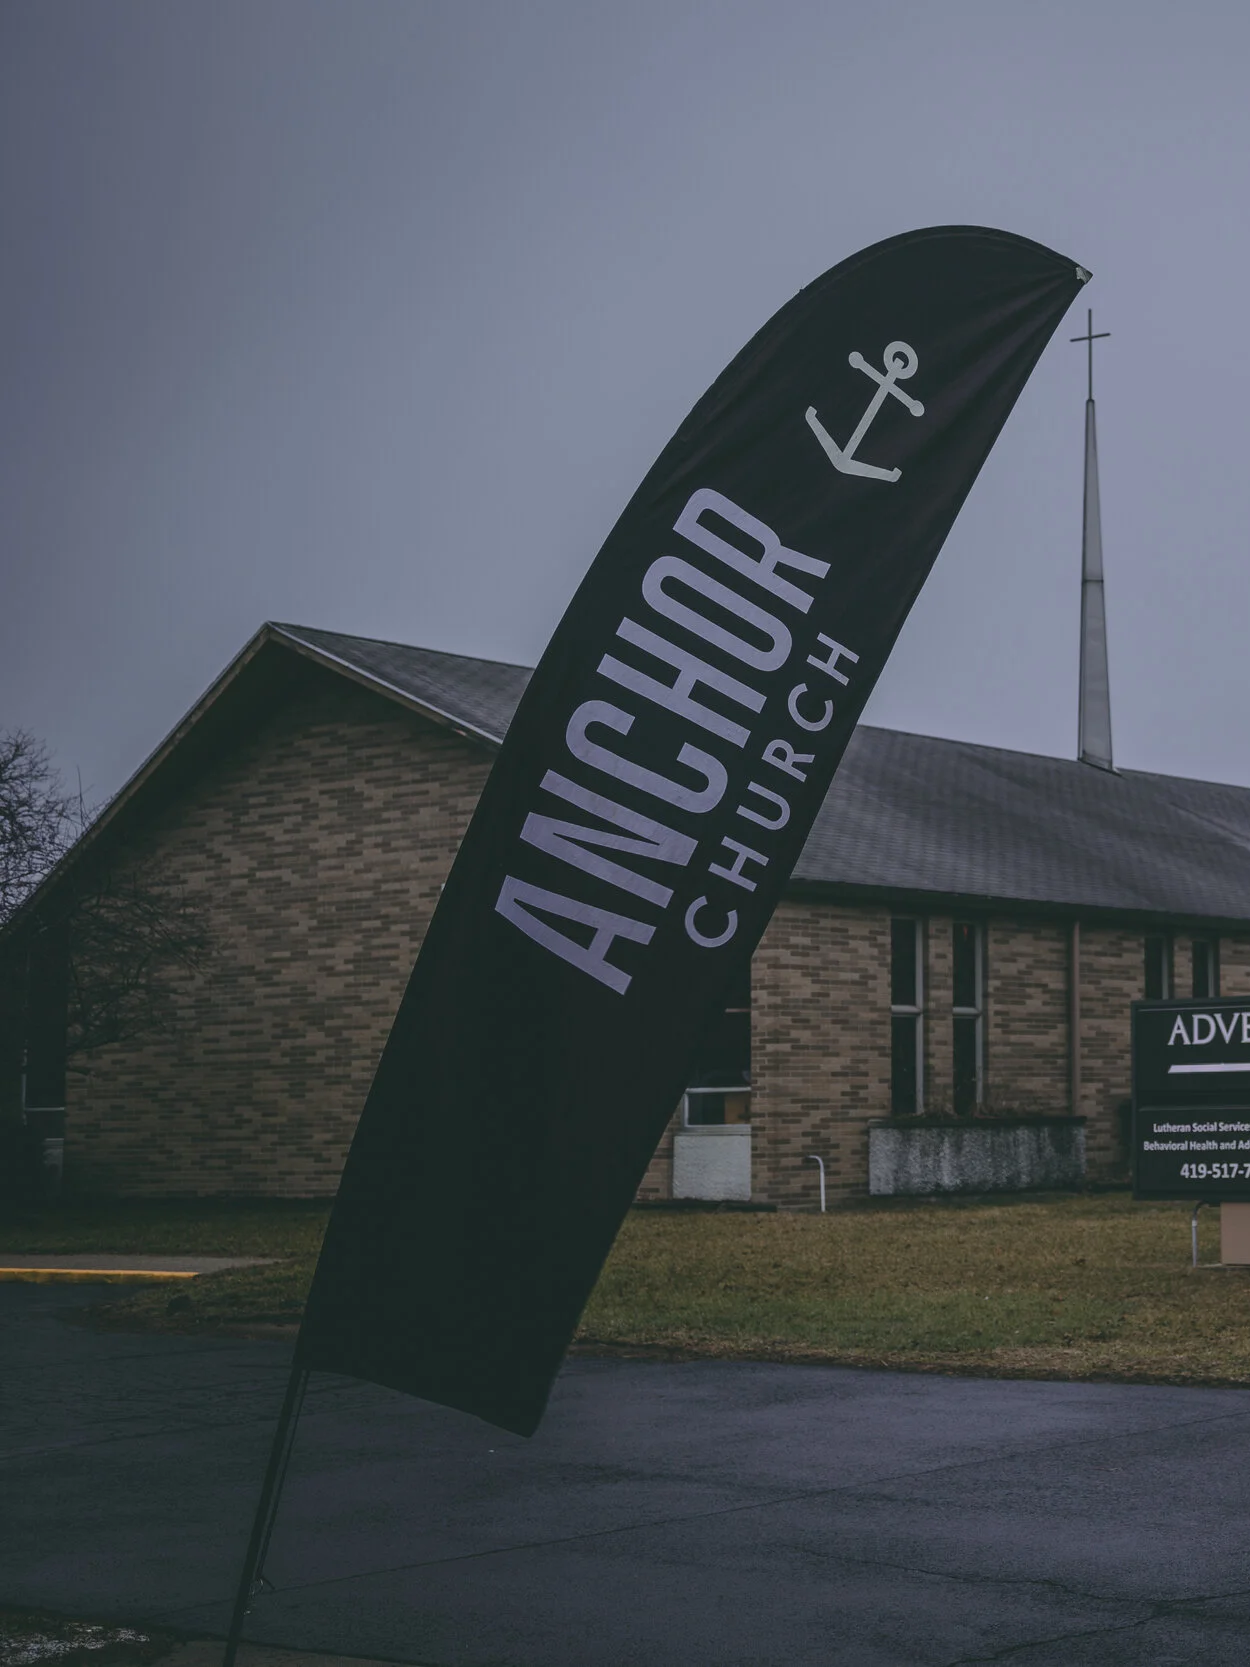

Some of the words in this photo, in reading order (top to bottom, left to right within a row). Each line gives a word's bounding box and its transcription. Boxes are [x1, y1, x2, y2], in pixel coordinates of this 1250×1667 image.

[494, 487, 832, 996] ANCHOR
[684, 631, 861, 948] CHURCH
[1143, 1140, 1189, 1151] Behavioral
[1189, 1139, 1219, 1151] Health
[1219, 1139, 1237, 1151] and
[1153, 1122, 1191, 1133] Lutheran
[1192, 1121, 1218, 1133] Social
